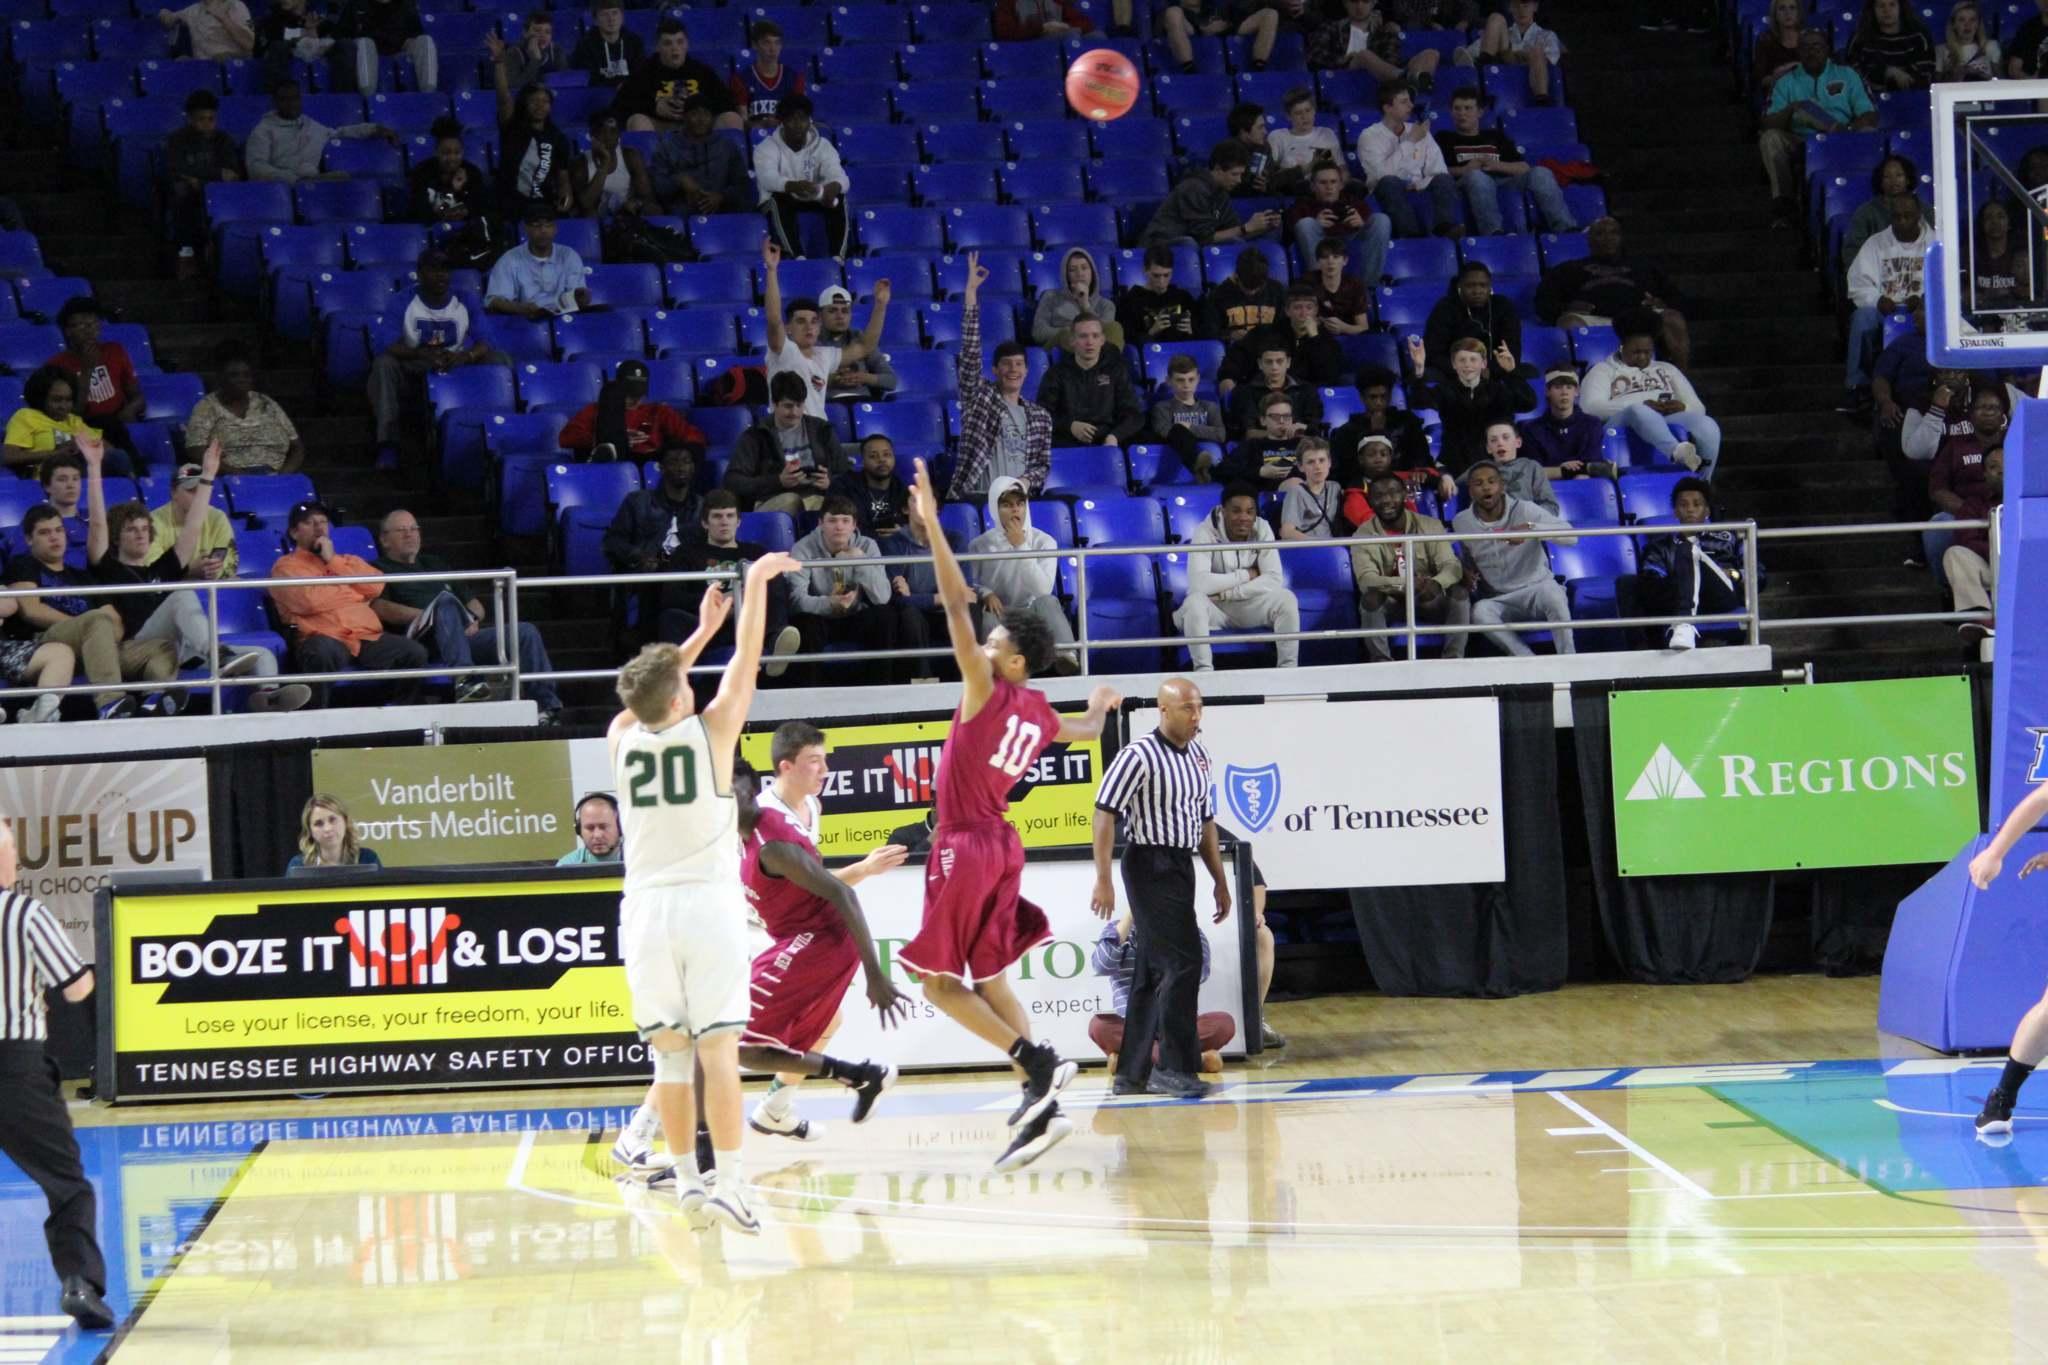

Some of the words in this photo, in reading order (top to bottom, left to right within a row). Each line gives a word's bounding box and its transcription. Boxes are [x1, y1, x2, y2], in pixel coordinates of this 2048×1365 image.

[1959, 338, 2004, 348] SPALDING
[988, 714, 1042, 777] 10
[625, 745, 698, 808] 20
[760, 769, 854, 797] BZE
[863, 767, 889, 793] IT
[1063, 754, 1089, 779] IT
[1719, 751, 1967, 798] REGIONS
[371, 773, 515, 805] Vanderbilt
[355, 815, 422, 840] ports
[430, 808, 558, 837] Medicine
[1025, 815, 1059, 833] your
[1064, 812, 1091, 827] life.
[1284, 805, 1317, 832] of
[1324, 804, 1489, 830] Tennessee
[3, 813, 114, 870] UEL
[127, 809, 196, 864] UP
[817, 830, 840, 845] our
[845, 826, 894, 843] licens
[140, 938, 287, 978] BOOZE
[302, 936, 343, 972] IT
[453, 930, 487, 967] &
[498, 926, 606, 965] LOSE
[185, 1017, 236, 1034] Lose
[242, 1015, 289, 1037] your
[296, 1012, 376, 1030] license,
[383, 1009, 428, 1031] your
[436, 1004, 530, 1024] freedom,
[537, 1005, 582, 1025] your
[590, 1000, 625, 1018] life.
[1032, 995, 1102, 1016] expect
[136, 1058, 298, 1082] TENNESSEE
[310, 1052, 436, 1076] HIGHWAY
[449, 1048, 552, 1070] SAFETY
